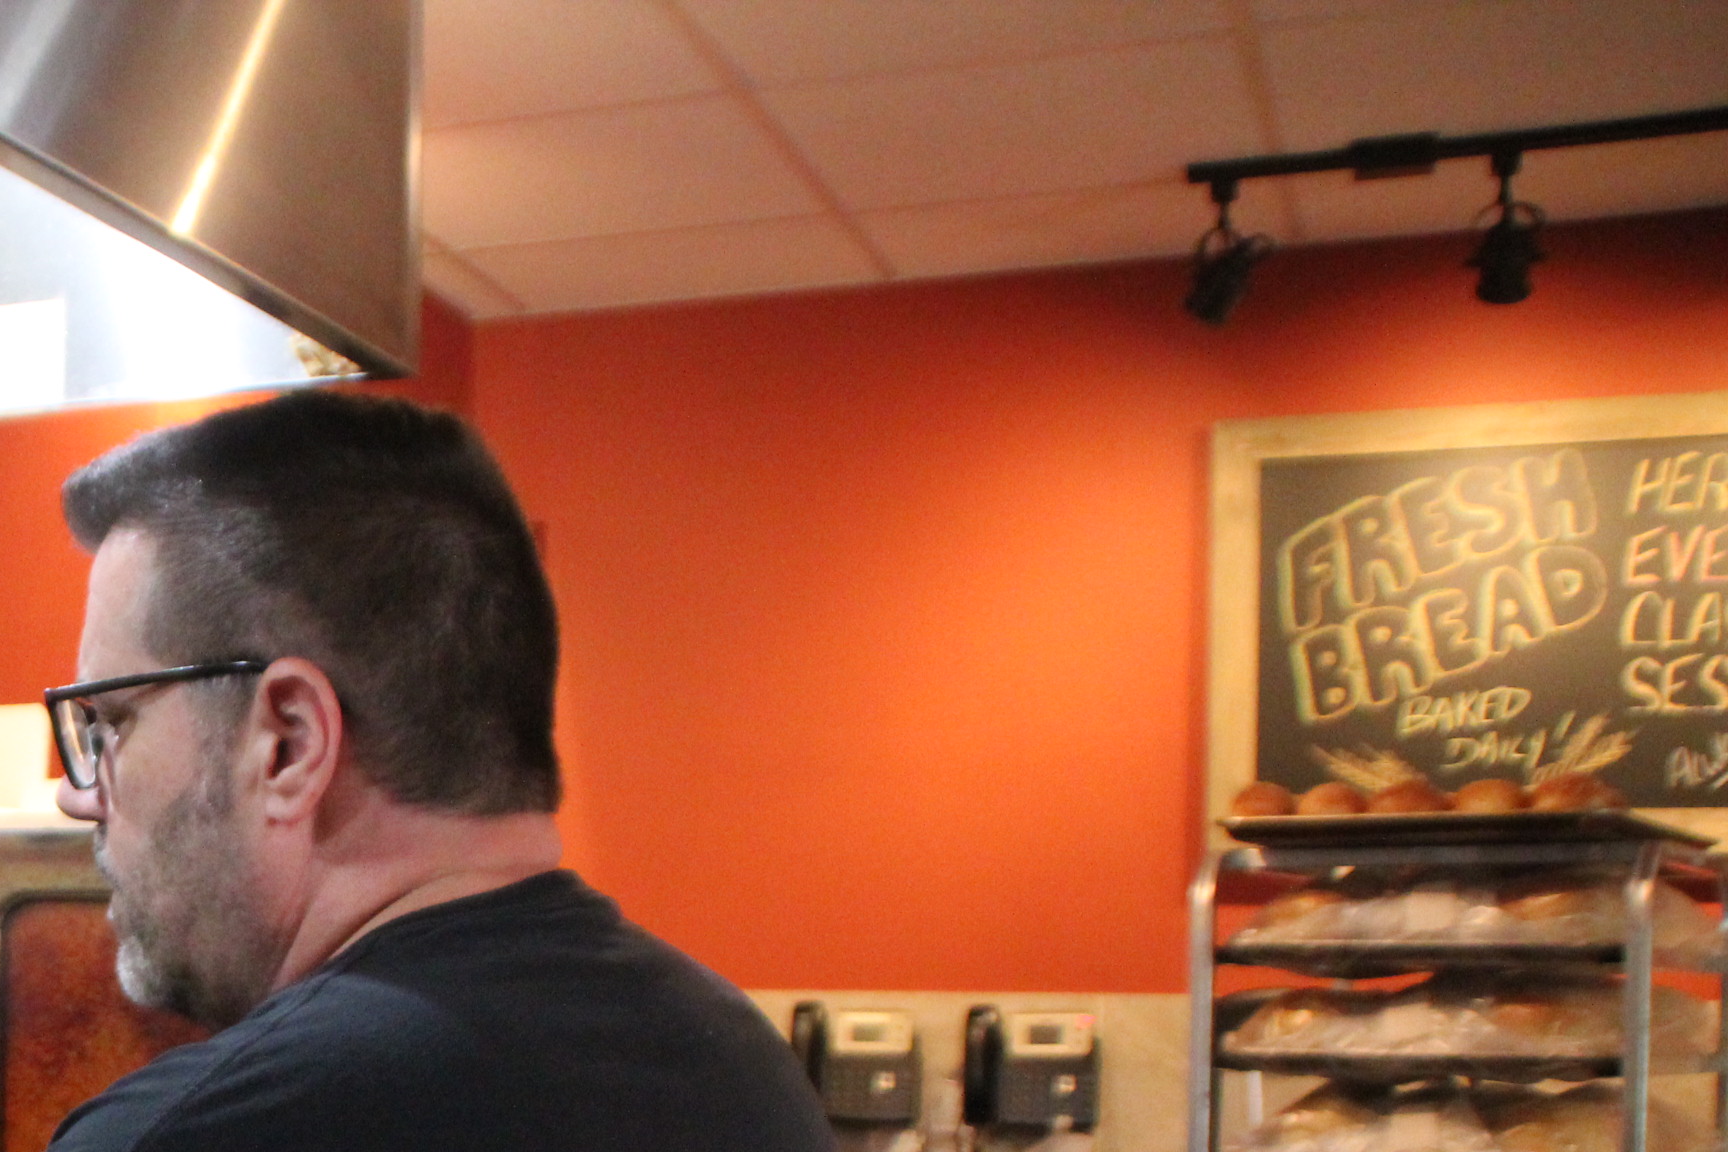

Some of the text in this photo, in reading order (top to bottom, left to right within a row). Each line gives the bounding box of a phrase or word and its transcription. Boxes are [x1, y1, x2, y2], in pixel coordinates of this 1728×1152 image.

[1278, 449, 1597, 633] FRESH
[1290, 545, 1607, 724] BREAD
[1397, 686, 1532, 738] BAKED
